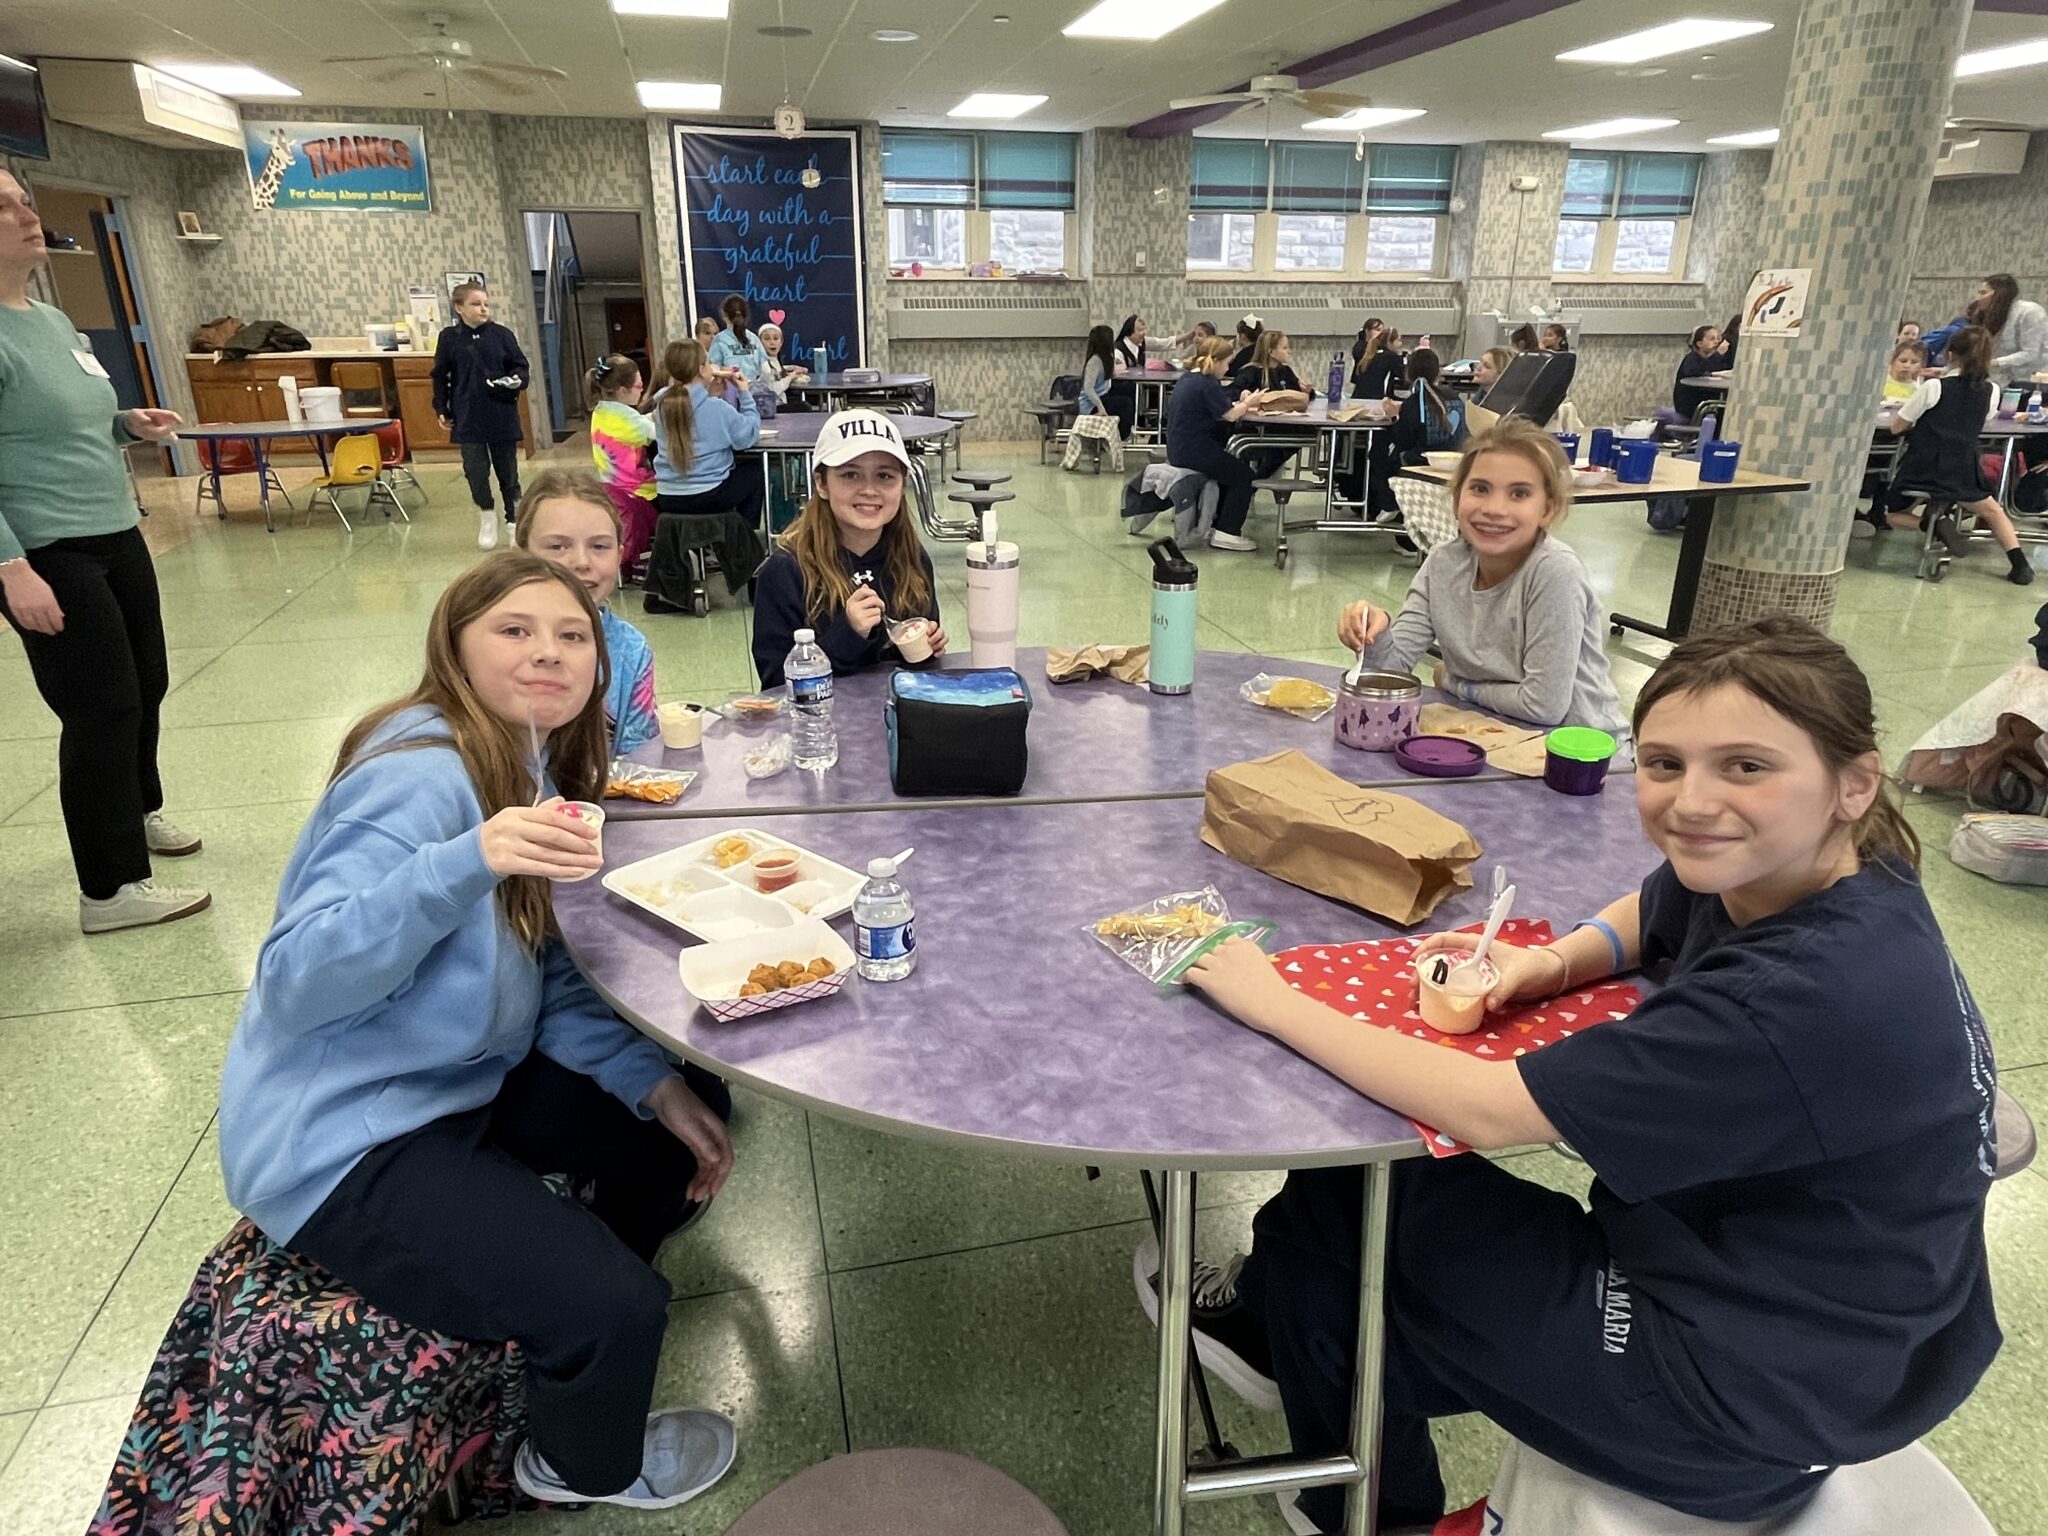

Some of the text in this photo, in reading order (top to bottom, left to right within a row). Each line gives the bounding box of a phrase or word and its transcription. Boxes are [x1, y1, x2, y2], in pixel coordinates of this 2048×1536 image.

[302, 136, 414, 179] THANKS
[707, 152, 827, 185] start eah
[289, 189, 425, 202] For Going Above and Beyond
[707, 192, 833, 237] day with a
[724, 233, 822, 275] grateful
[743, 271, 808, 302] heart
[791, 332, 849, 360] hert
[838, 419, 896, 444] VILLA
[1603, 1289, 1632, 1354] MARIA
